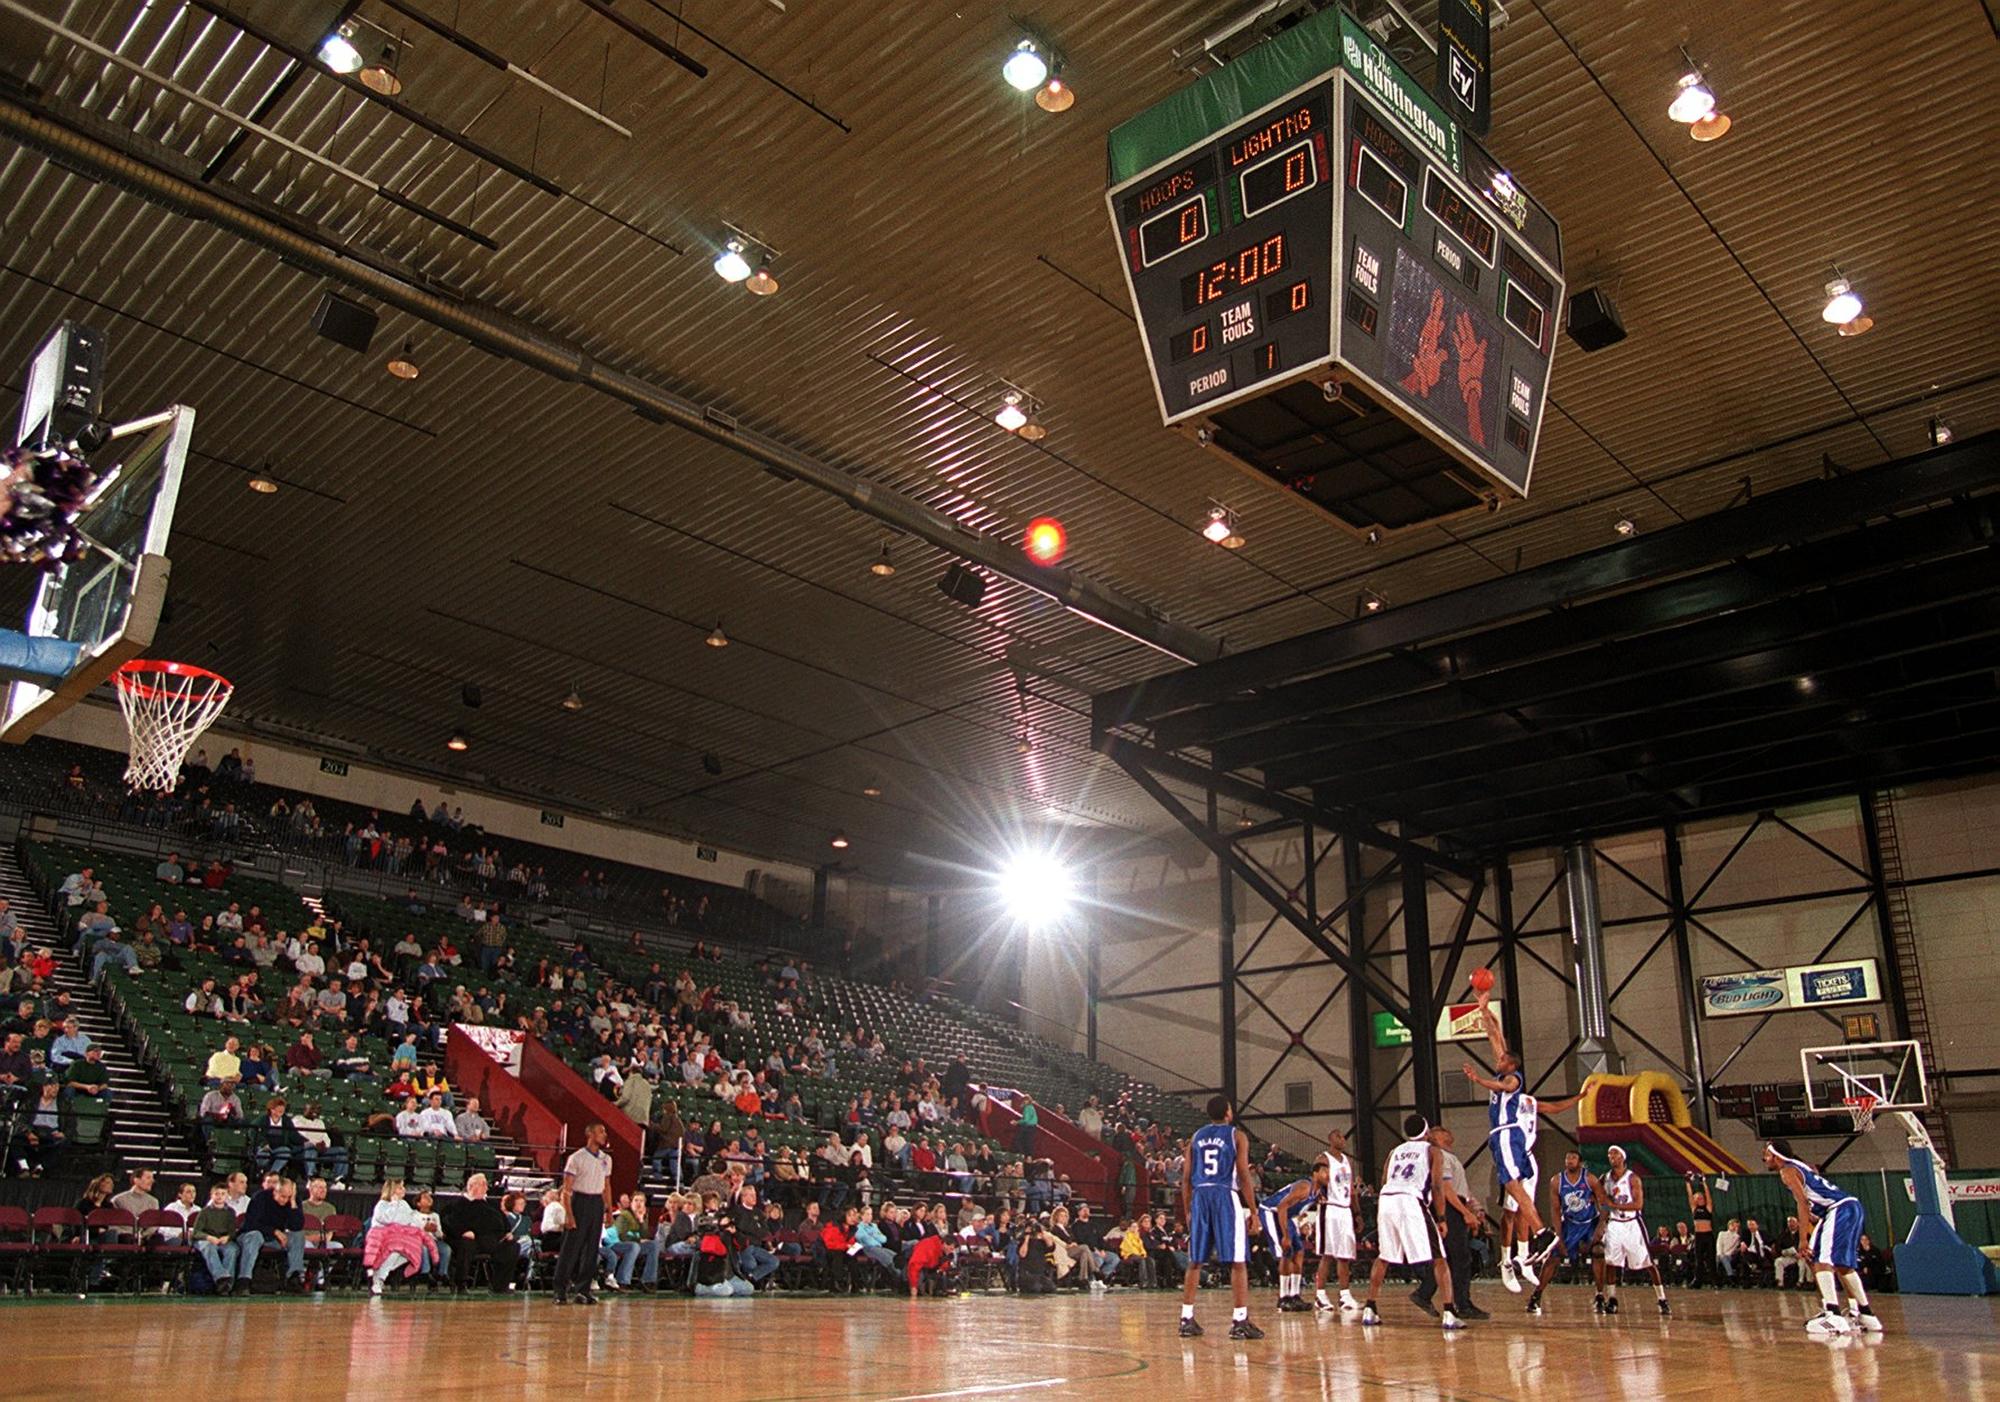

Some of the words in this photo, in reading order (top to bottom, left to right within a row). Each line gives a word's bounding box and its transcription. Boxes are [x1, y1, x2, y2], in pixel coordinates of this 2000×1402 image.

[1453, 56, 1473, 97] EV
[1363, 52, 1446, 151] Huntington
[1231, 108, 1312, 167] LIGHTNG
[1285, 151, 1305, 192] 0
[1180, 205, 1198, 243] 0
[1358, 247, 1379, 277] TEAM
[1437, 239, 1461, 270] PERIOD
[1198, 235, 1282, 304] 12:00
[1355, 263, 1377, 294] FOULS
[1292, 282, 1307, 311] 0
[1221, 301, 1251, 327] TEAM
[1193, 326, 1206, 353] 0
[1222, 318, 1254, 344] FOULS
[1268, 344, 1273, 369] 1
[1190, 368, 1227, 396] PERIOD
[1513, 376, 1530, 401] TEAM
[1511, 391, 1530, 416] FOULS
[1816, 975, 1848, 989] TICKETS
[1204, 1149, 1218, 1175] 5
[1966, 1184, 2000, 1195] FAR
